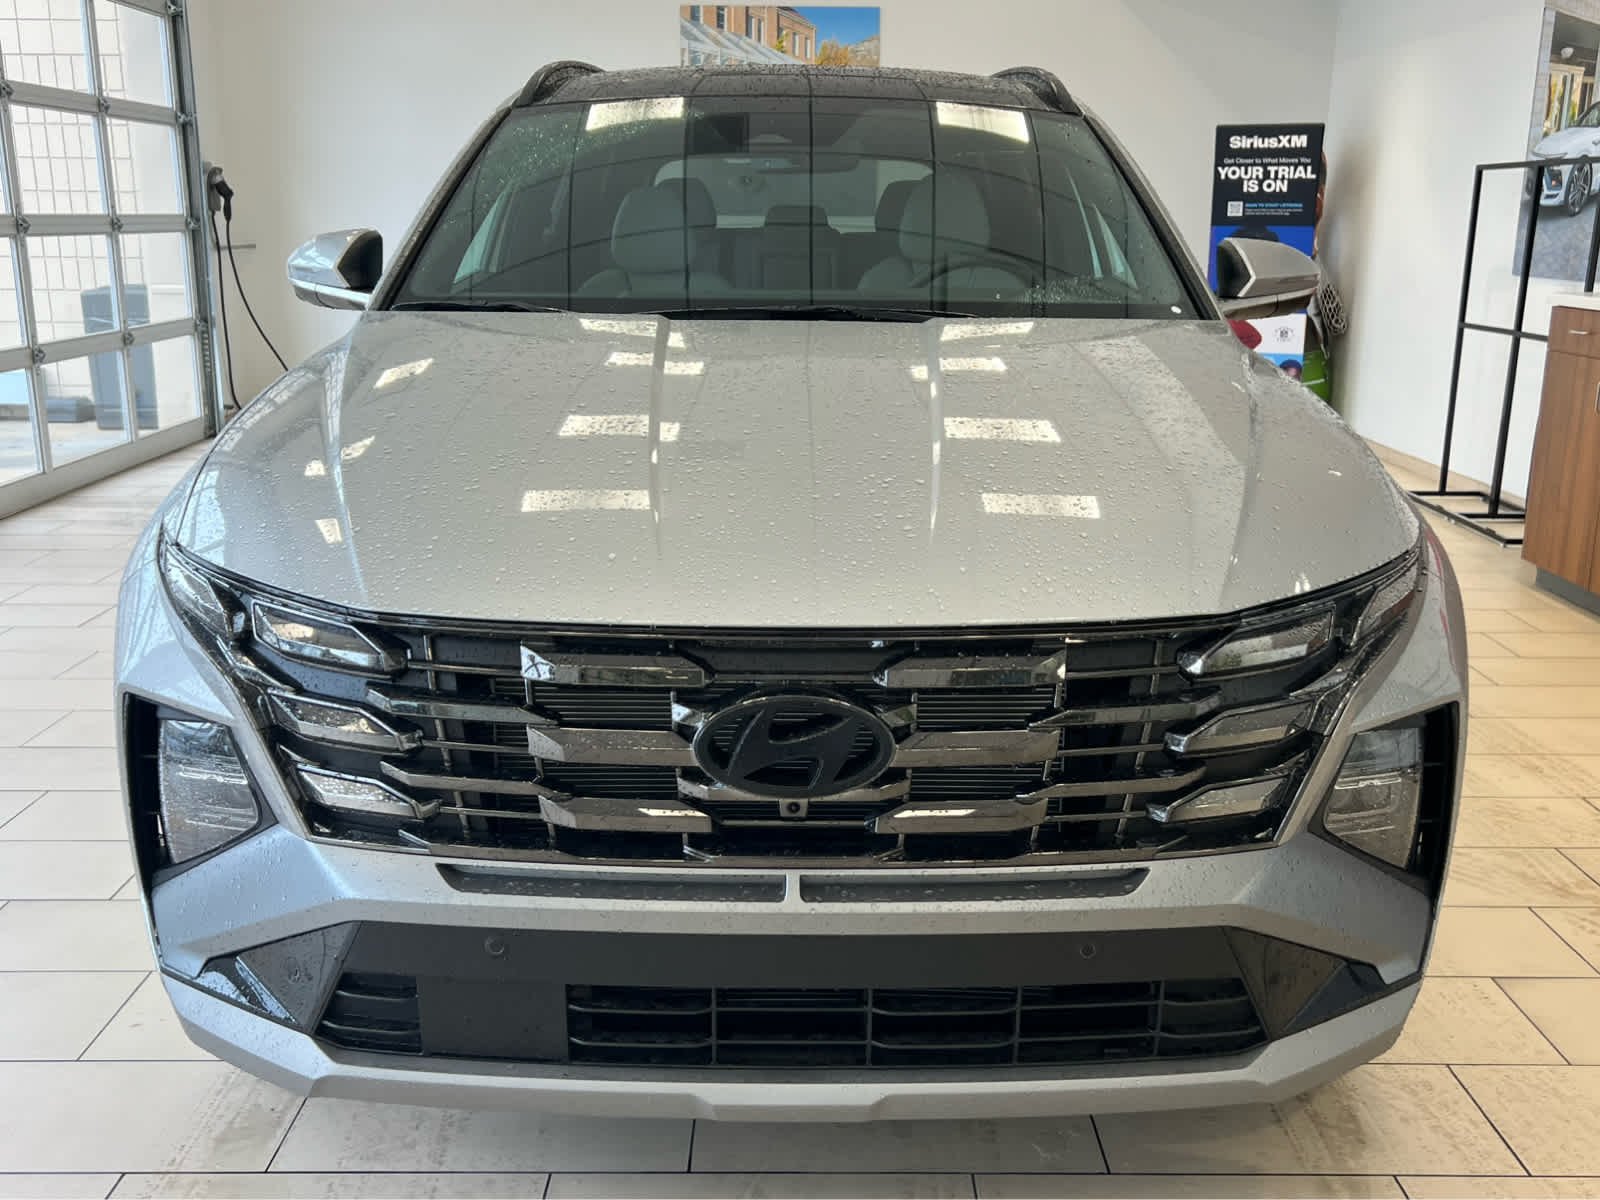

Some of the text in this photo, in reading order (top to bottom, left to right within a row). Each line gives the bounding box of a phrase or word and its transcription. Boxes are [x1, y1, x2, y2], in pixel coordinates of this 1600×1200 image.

[1229, 134, 1308, 149] SiriusXM
[1223, 157, 1235, 165] Get
[1236, 157, 1254, 165] Closer
[1300, 156, 1312, 164] You
[1217, 165, 1317, 180] YOUR TRIAL
[1243, 180, 1288, 193] IS ON
